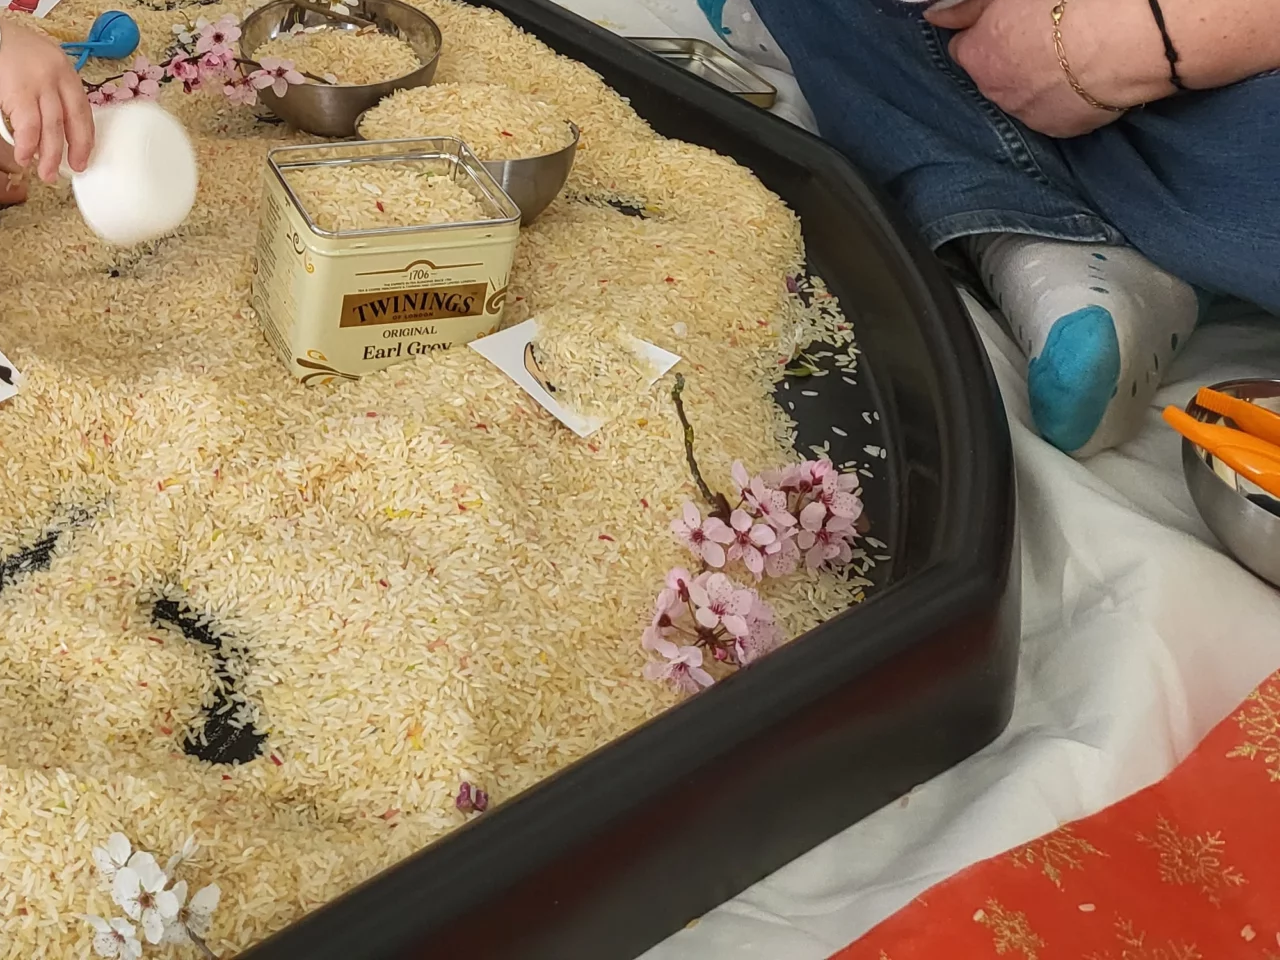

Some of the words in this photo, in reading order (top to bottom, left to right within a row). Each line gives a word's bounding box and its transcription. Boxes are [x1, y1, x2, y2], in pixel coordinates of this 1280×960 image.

[409, 269, 429, 281] 1706
[352, 292, 474, 323] TWININGS
[405, 312, 434, 320] LONDON
[382, 325, 438, 339] ORIGINAL
[362, 342, 402, 361] Earl
